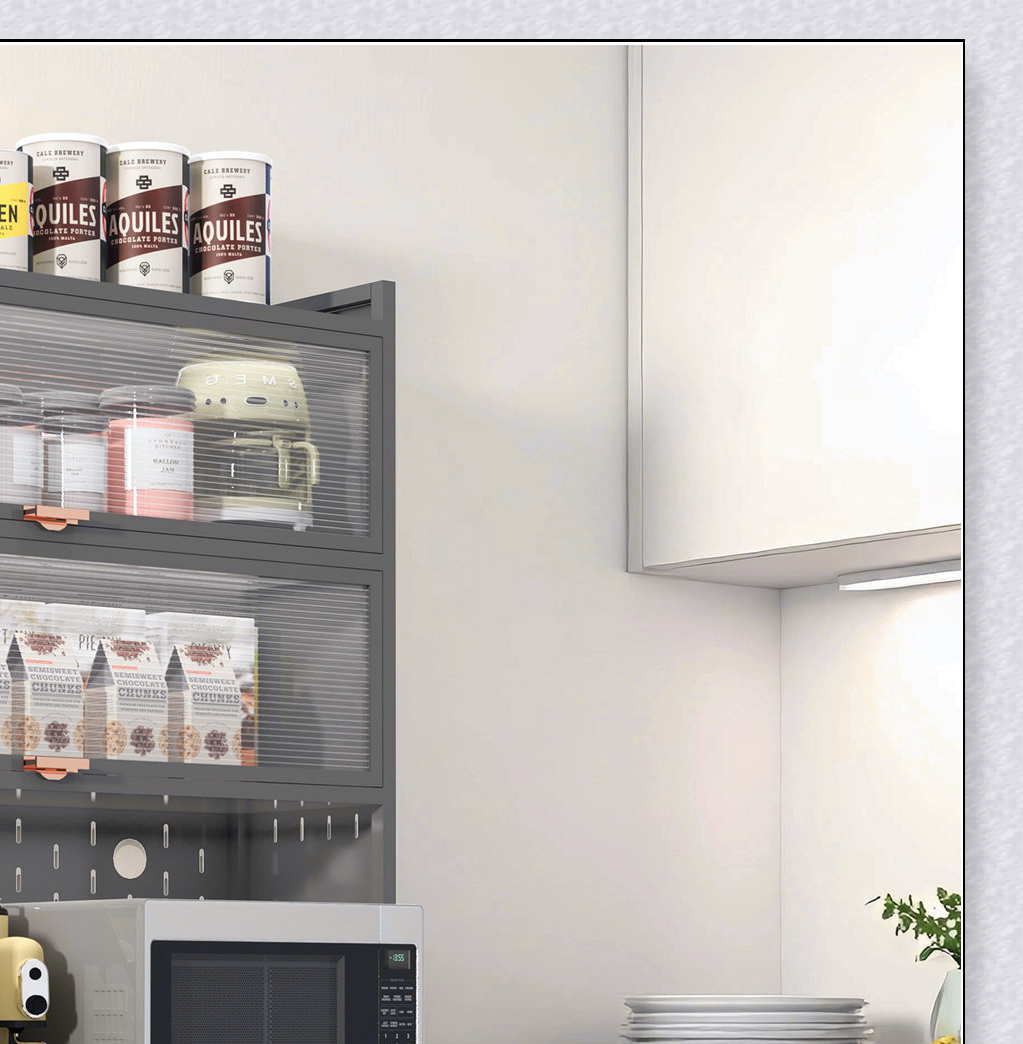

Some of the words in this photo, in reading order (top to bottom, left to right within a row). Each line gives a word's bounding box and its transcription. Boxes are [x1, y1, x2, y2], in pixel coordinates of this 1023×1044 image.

[109, 211, 179, 236] AQUILES
[71, 228, 95, 236] PORTER
[194, 220, 262, 244] AQUILES
[111, 236, 151, 245] CHOCOLATE
[154, 236, 178, 244] PORTER
[195, 244, 234, 253] CHOCOLATE
[238, 244, 261, 252] PORTER
[79, 634, 96, 651] PIE
[28, 667, 77, 675] SEMISWEET
[31, 674, 81, 682] CHOCOLATE
[114, 672, 163, 681] SEMISWEET
[188, 677, 235, 685] SEMISWEET
[32, 682, 82, 694] CHUNKS
[116, 679, 166, 688] CHOCOLATE
[191, 684, 240, 693] CHOCOLATE
[118, 688, 167, 699] CHUNKS
[192, 692, 240, 704] CHUNKS
